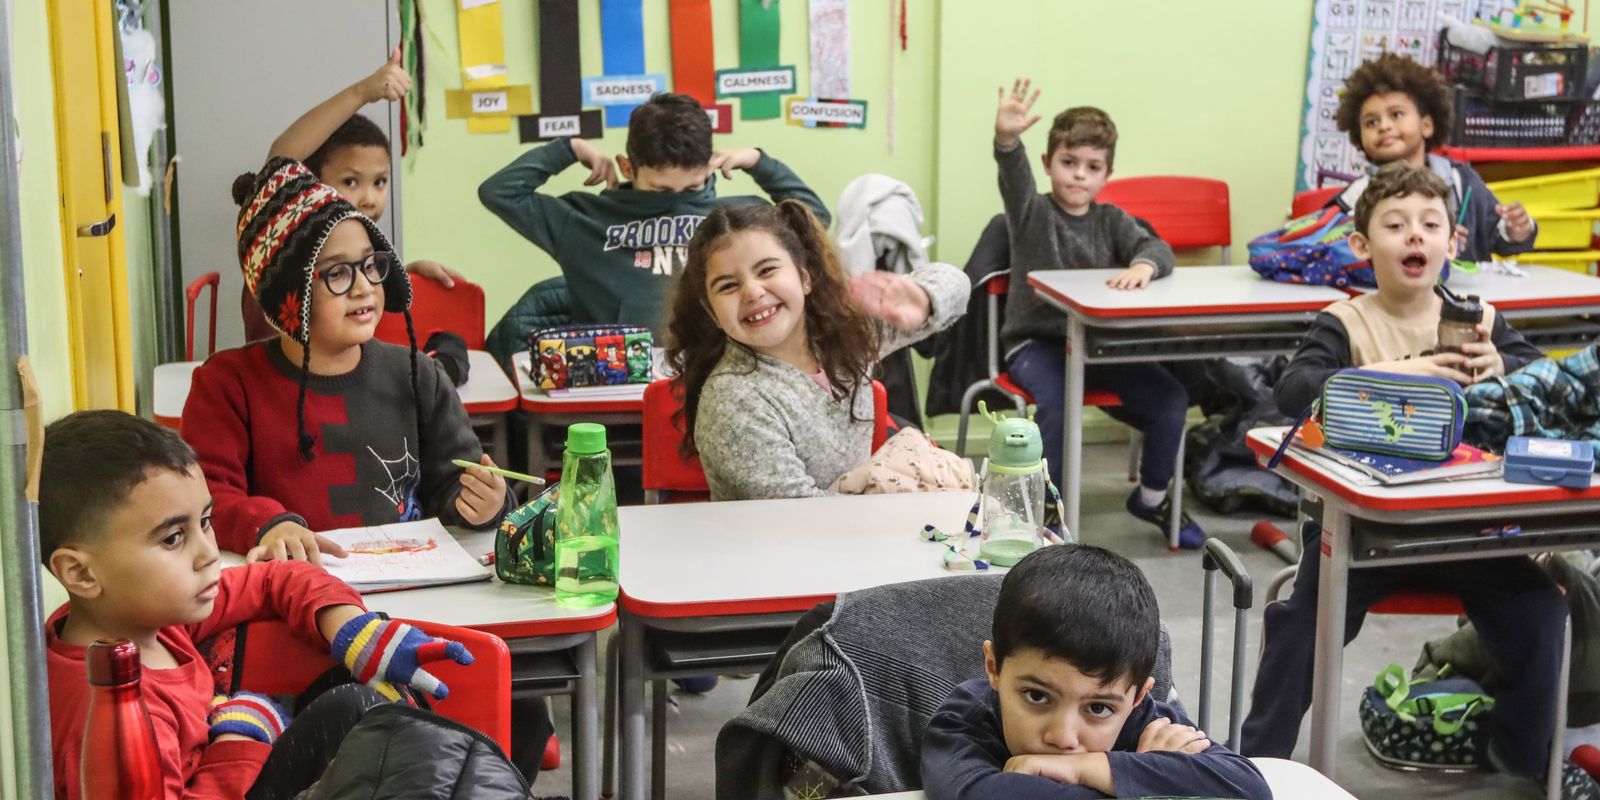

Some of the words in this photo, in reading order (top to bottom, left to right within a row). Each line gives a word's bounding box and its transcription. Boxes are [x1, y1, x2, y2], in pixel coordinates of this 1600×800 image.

[1331, 3, 1341, 16] G
[1366, 5, 1376, 17] H
[724, 75, 787, 88] CALMNESS
[596, 84, 652, 96] SADNESS
[478, 97, 500, 107] JOY
[792, 106, 861, 118] CONFUSION
[544, 121, 576, 131] FEAR
